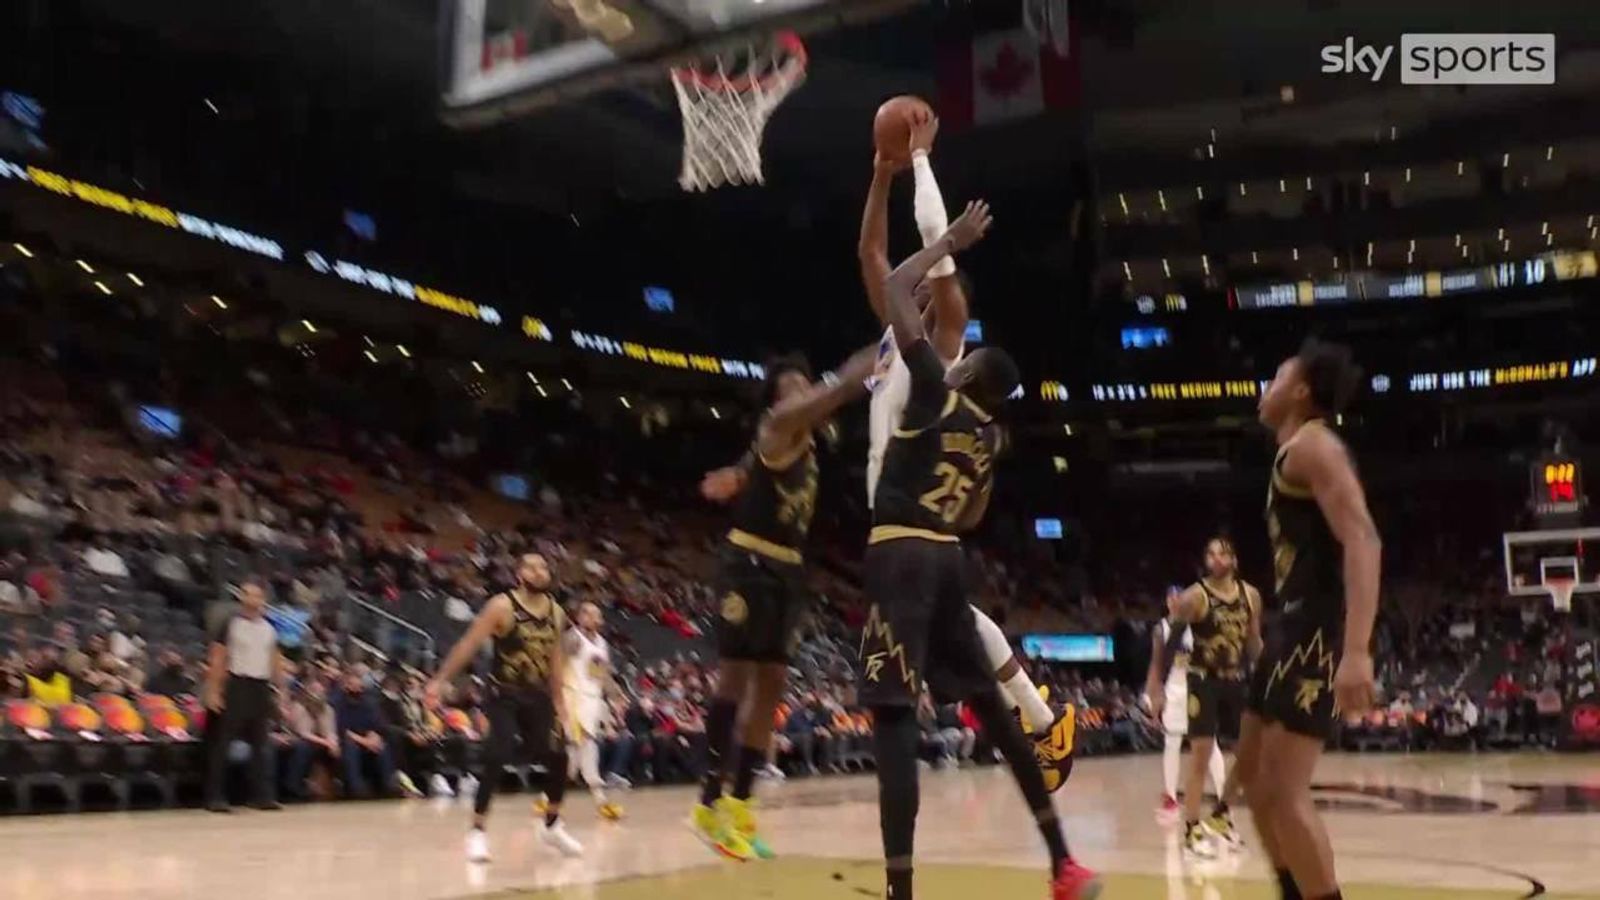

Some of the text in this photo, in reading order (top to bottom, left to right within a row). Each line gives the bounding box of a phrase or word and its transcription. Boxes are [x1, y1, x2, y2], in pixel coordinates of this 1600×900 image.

[1151, 383, 1176, 400] FREE
[1180, 382, 1221, 399] MEDIUM
[1410, 373, 1438, 391] JUST
[1443, 372, 1465, 389] USE
[1469, 369, 1491, 386] THE
[1572, 357, 1597, 377] APP
[918, 461, 974, 523] 25
